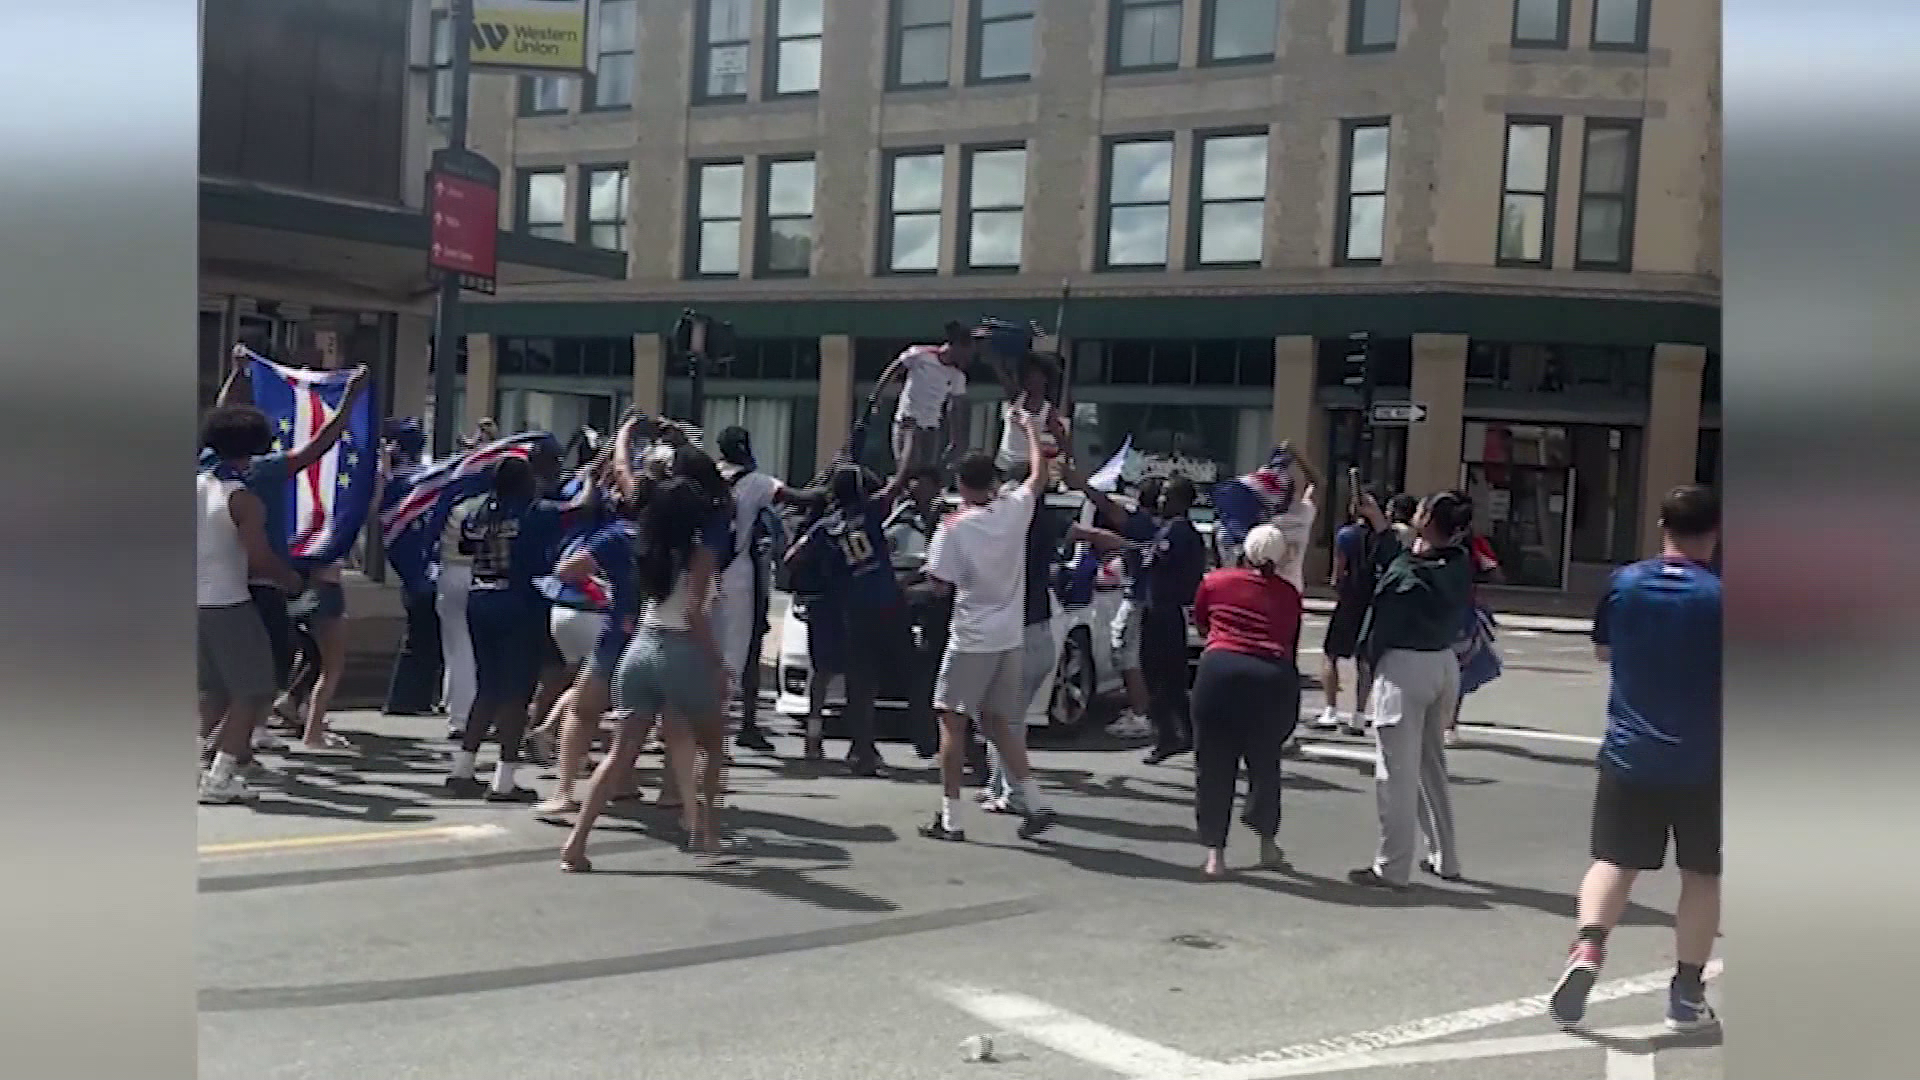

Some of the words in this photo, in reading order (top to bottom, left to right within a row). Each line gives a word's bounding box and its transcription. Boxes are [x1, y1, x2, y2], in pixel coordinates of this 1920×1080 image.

[513, 24, 578, 42] Western
[513, 39, 560, 55] Union
[839, 529, 875, 566] 10
